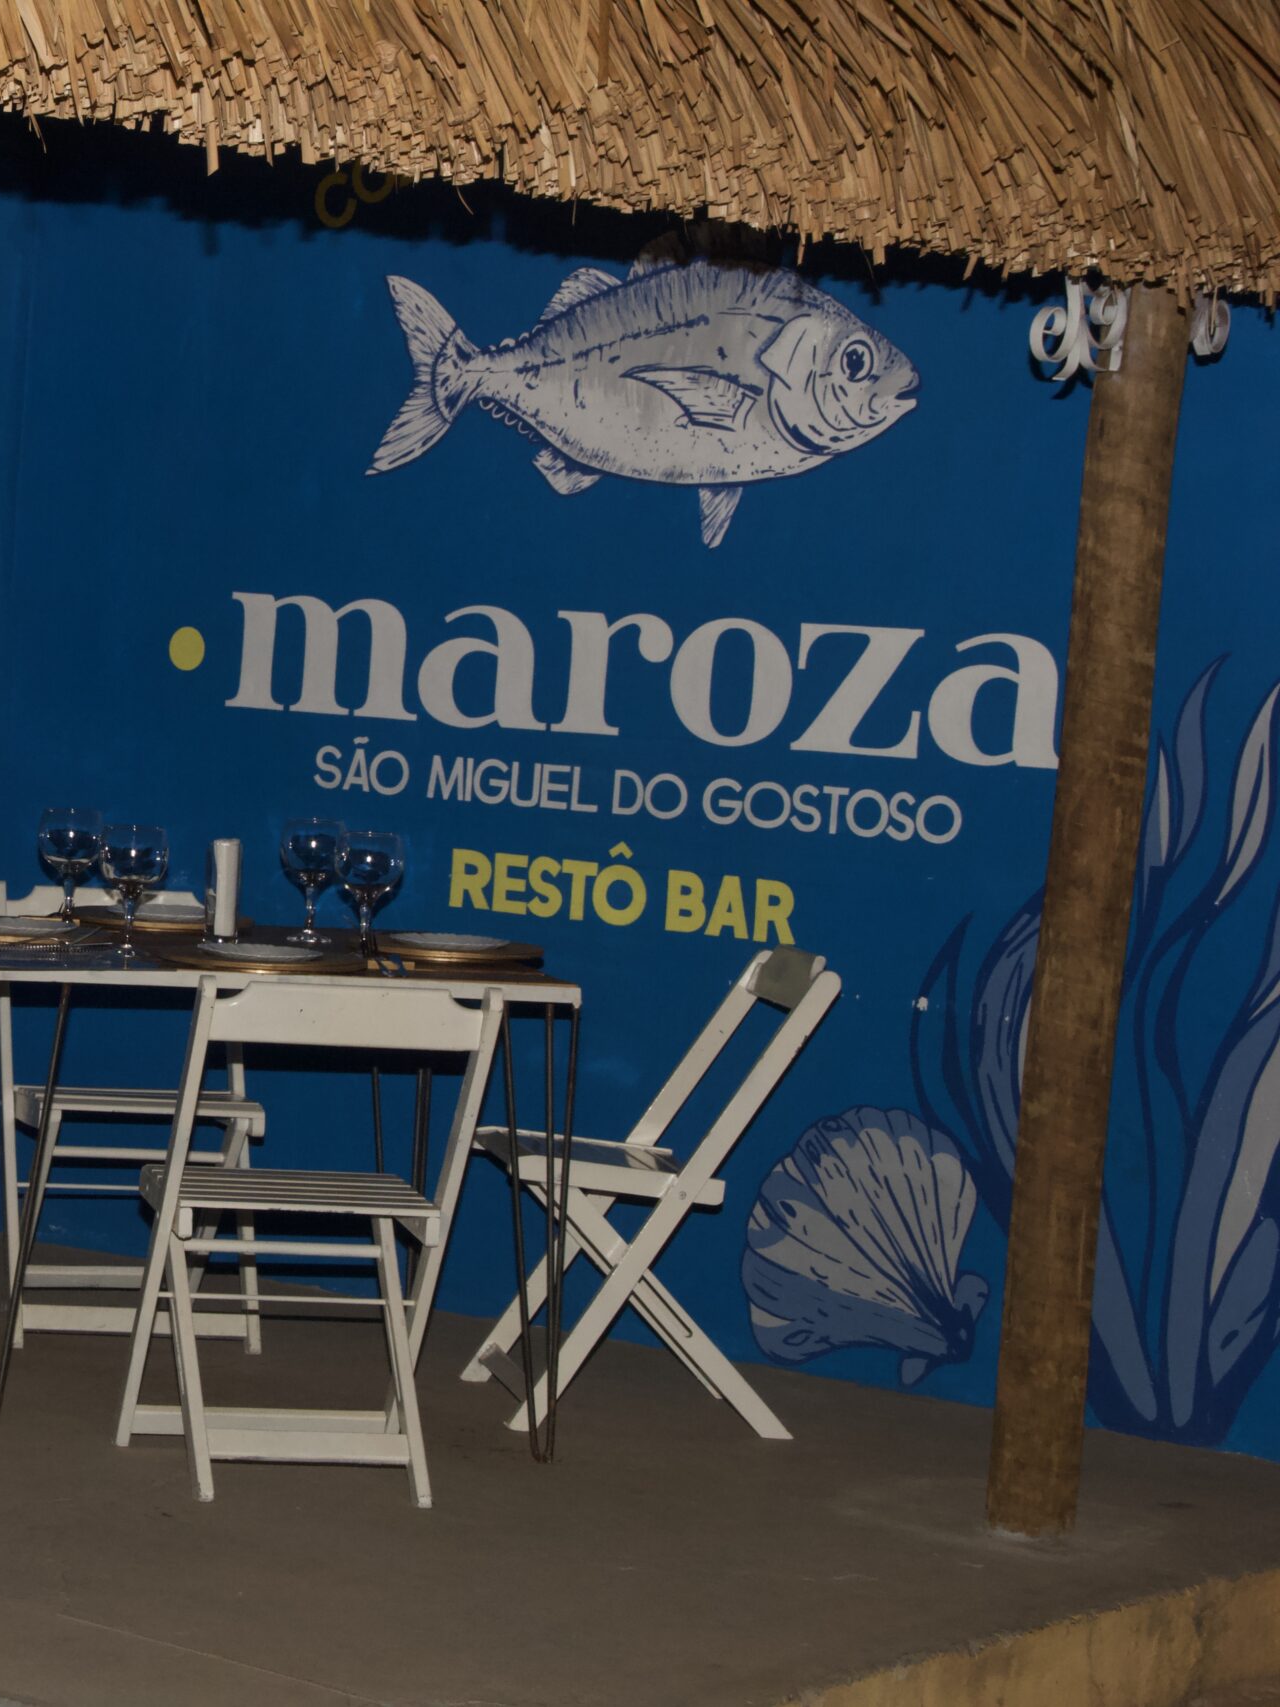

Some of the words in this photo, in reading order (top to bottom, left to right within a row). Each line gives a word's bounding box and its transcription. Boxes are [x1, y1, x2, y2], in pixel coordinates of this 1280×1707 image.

[225, 592, 1061, 770] maroza
[313, 737, 410, 796] SÃO
[426, 755, 599, 813] MIGUEL
[612, 770, 690, 820] DO
[702, 778, 963, 845] GOSTOSO
[449, 843, 648, 927] RESTÔ
[665, 870, 796, 946] BAR
